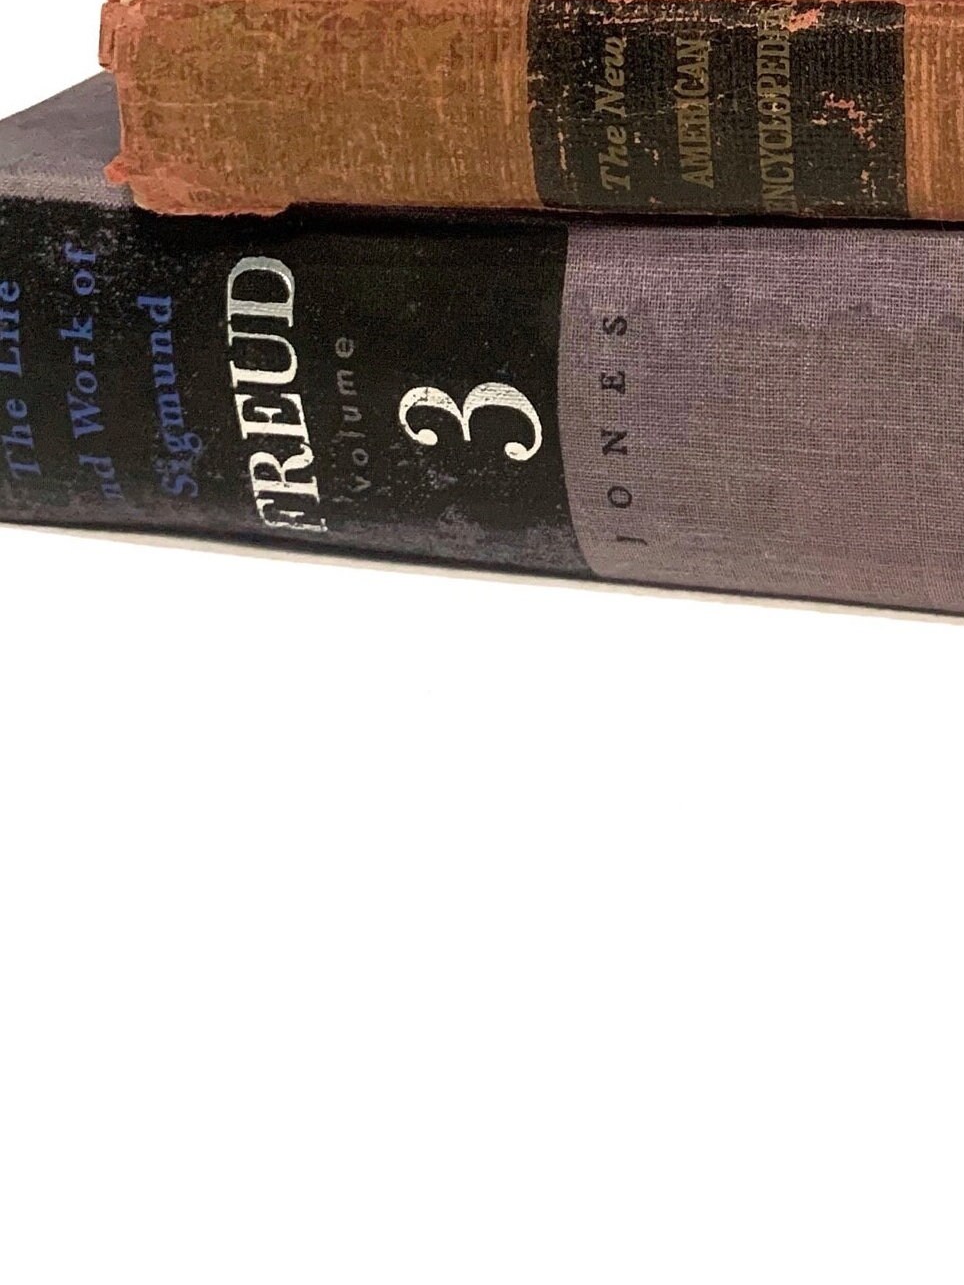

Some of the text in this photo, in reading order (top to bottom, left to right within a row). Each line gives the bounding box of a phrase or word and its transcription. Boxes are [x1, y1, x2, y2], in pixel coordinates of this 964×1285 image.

[595, 36, 632, 191] The New
[675, 36, 714, 189] AMERICAN
[0, 398, 41, 480] The
[60, 242, 123, 500] nd Work of
[136, 294, 203, 498] Sigmund
[227, 256, 328, 533] FREUD
[334, 336, 371, 491] volume
[399, 381, 543, 462] 3
[599, 315, 647, 546] JONES
